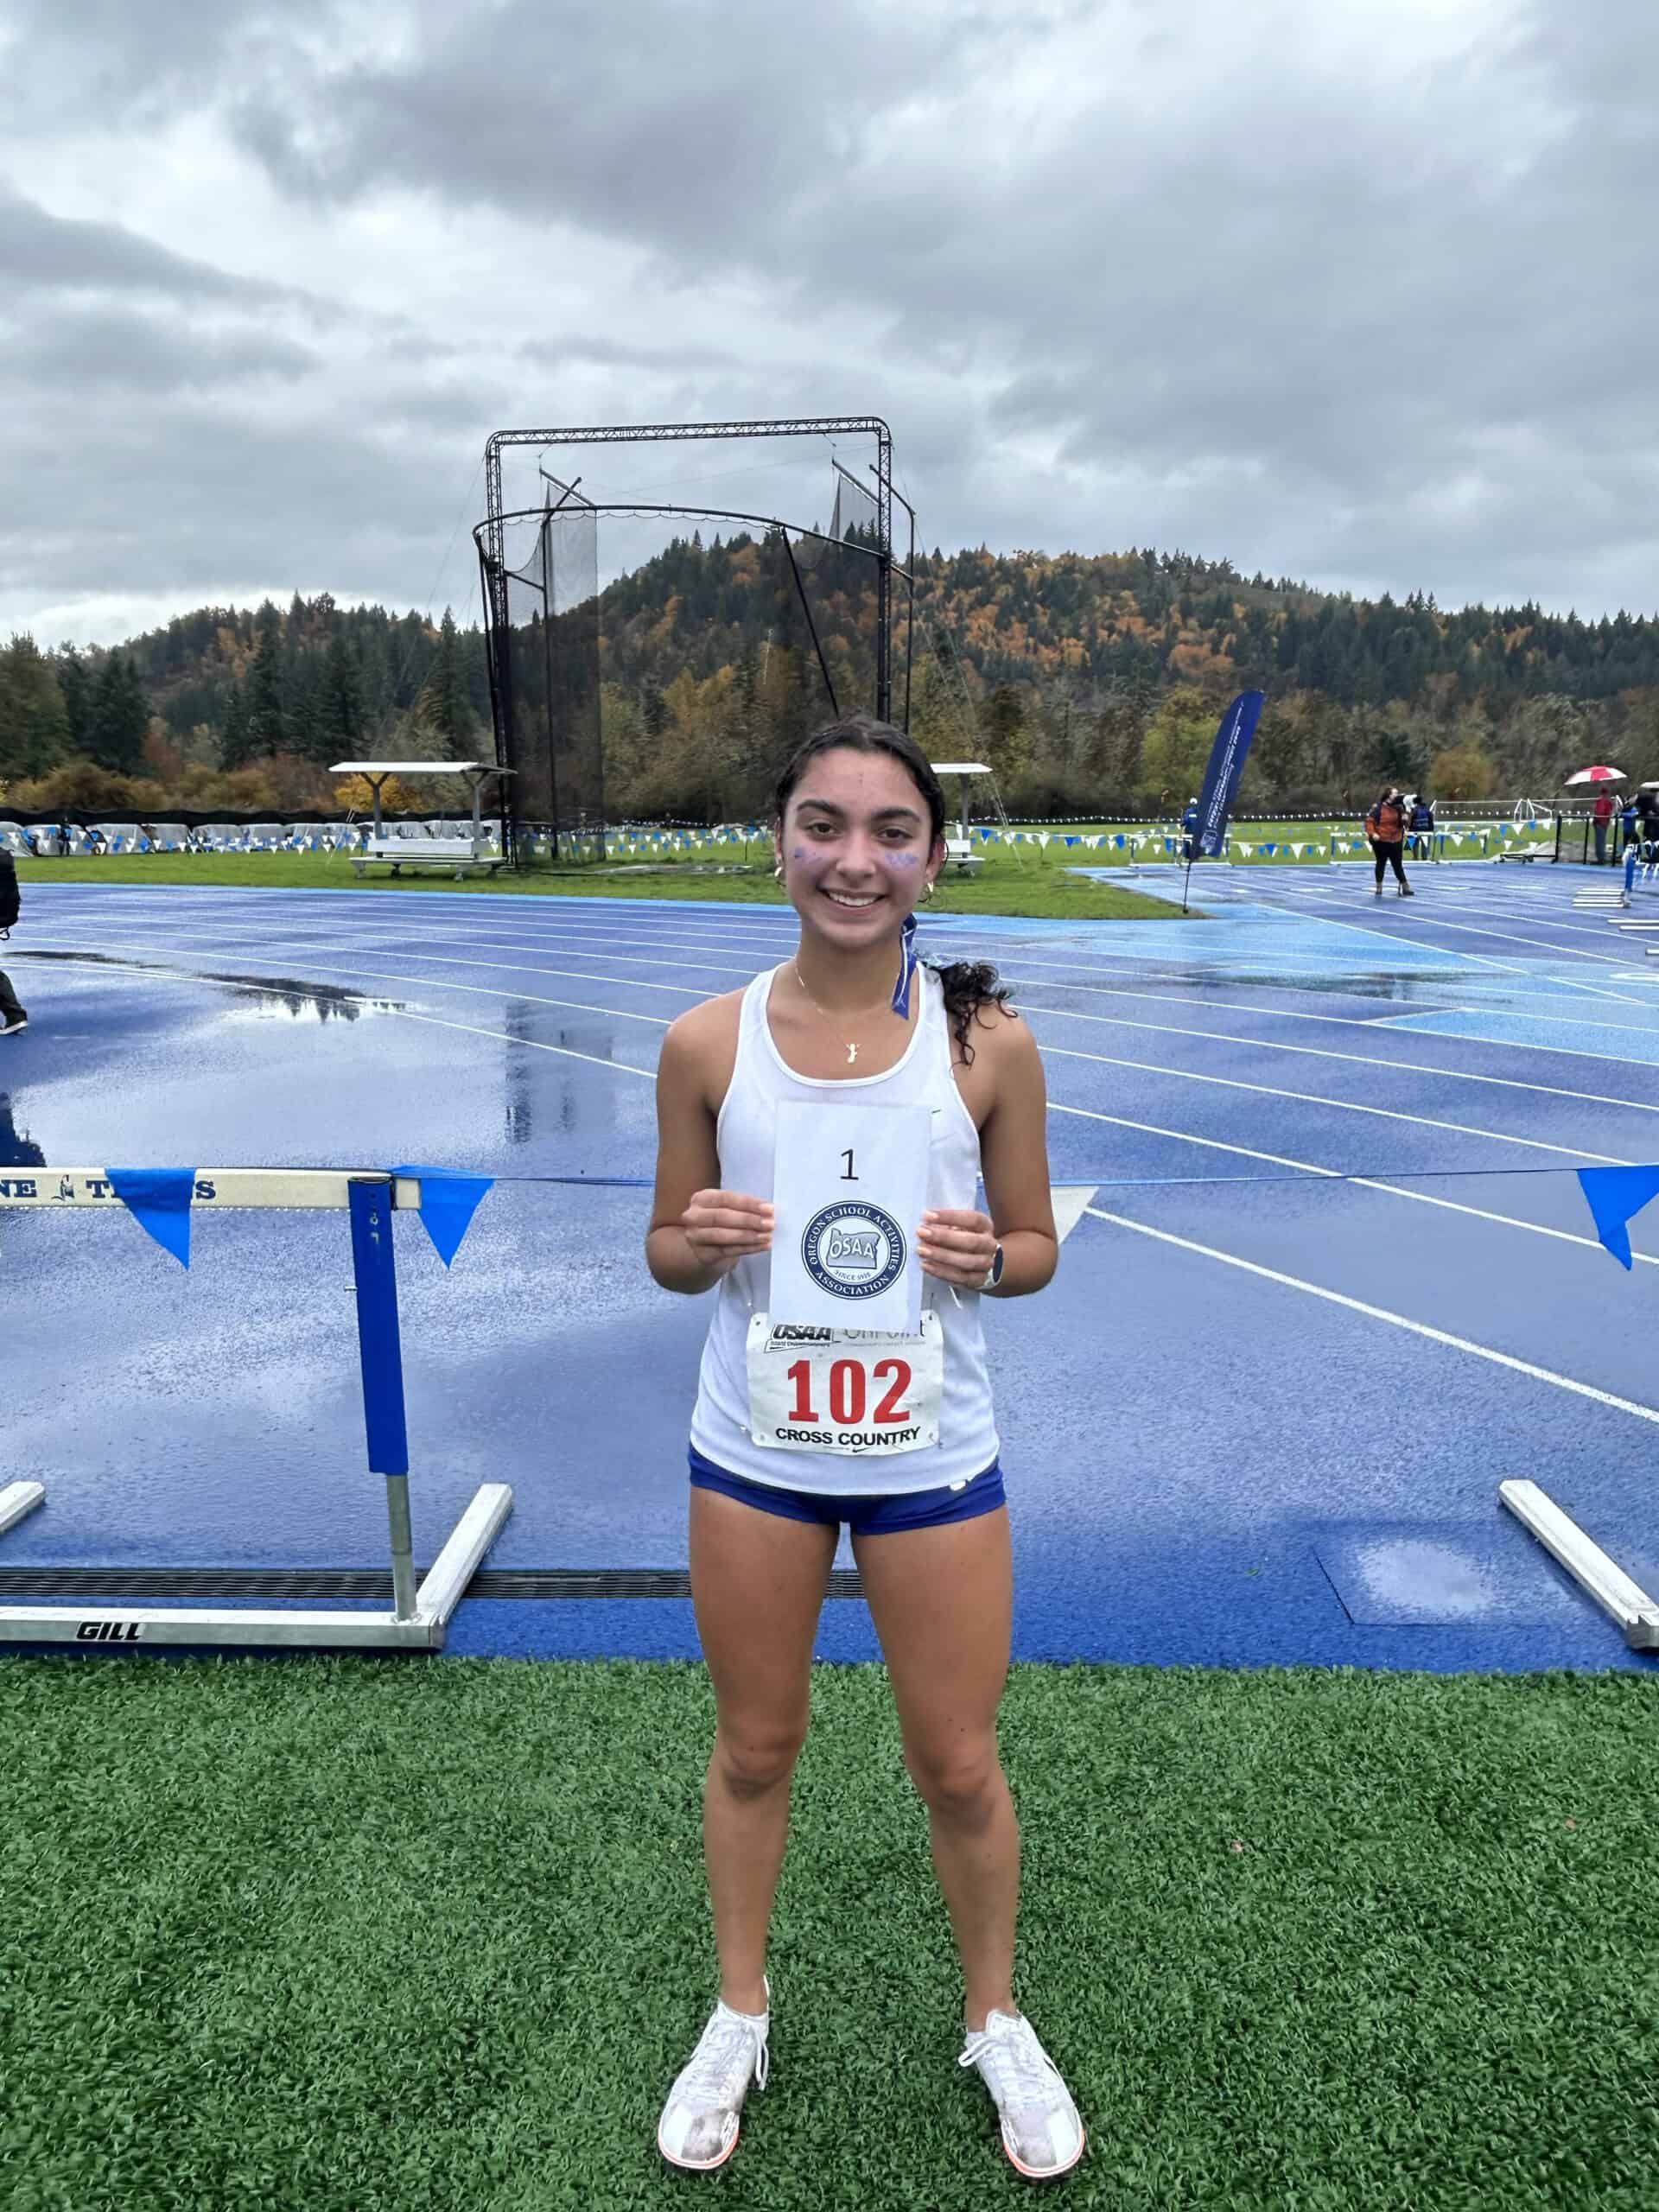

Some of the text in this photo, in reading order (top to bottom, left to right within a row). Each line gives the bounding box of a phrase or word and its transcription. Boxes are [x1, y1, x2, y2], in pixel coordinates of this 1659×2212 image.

[840, 1148, 859, 1180] 1
[808, 1206, 899, 1271] OREGON SCHOOL ACTIVITIES
[829, 1236, 874, 1260] OSAA
[815, 1272, 890, 1296] ASSOCIATION
[833, 1269, 855, 1281] SINCE
[787, 1359, 912, 1425] 102
[775, 1426, 921, 1446] CROSS COUNTRY
[76, 1622, 143, 1641] GILL
